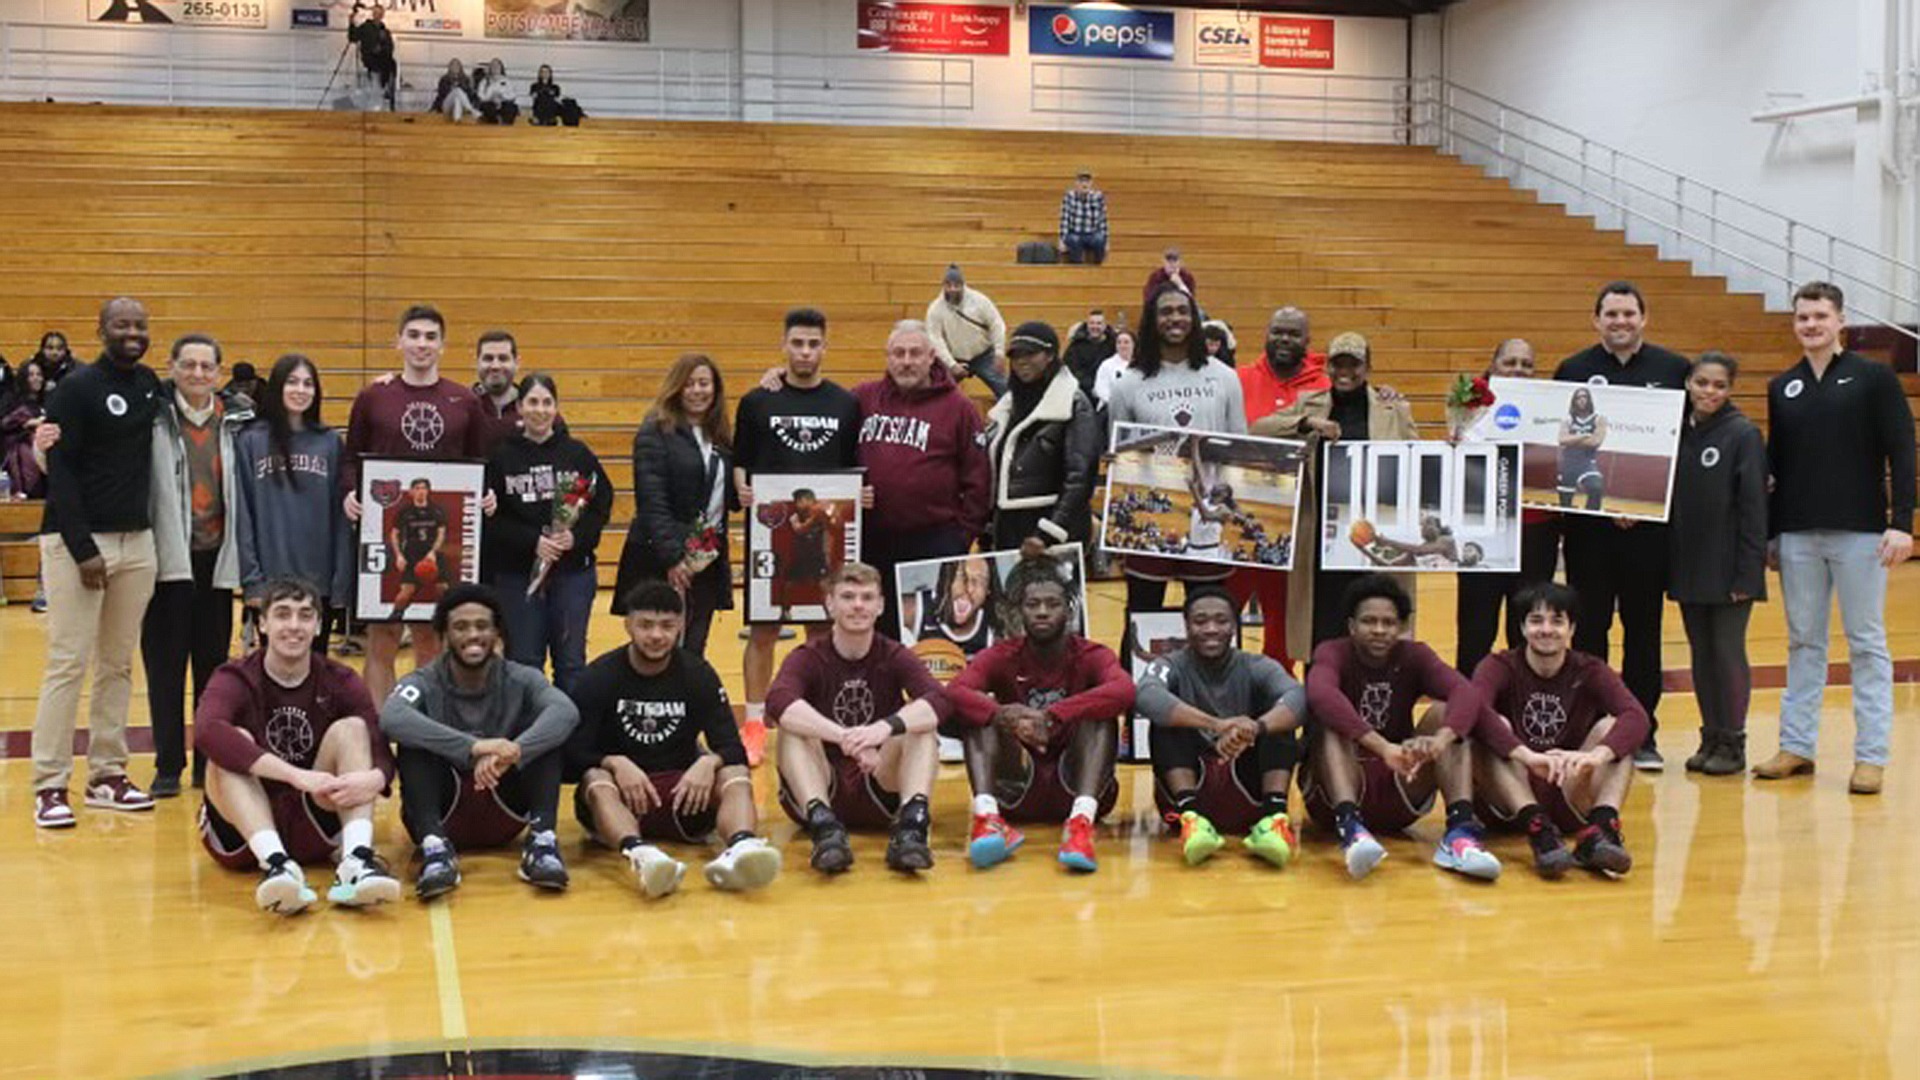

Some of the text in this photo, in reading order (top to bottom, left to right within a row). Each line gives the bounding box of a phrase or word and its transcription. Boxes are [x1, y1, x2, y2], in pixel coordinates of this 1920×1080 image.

[183, 2, 261, 17] 265-0133
[1085, 23, 1153, 48] pepsi
[1199, 27, 1251, 45] CSEA
[776, 428, 834, 453] BASKETBALL
[859, 413, 931, 452] POTSDAM
[1346, 445, 1499, 535] 1000
[367, 544, 386, 572] 5
[757, 551, 775, 578] 3
[621, 715, 680, 744] BASKETBALL
